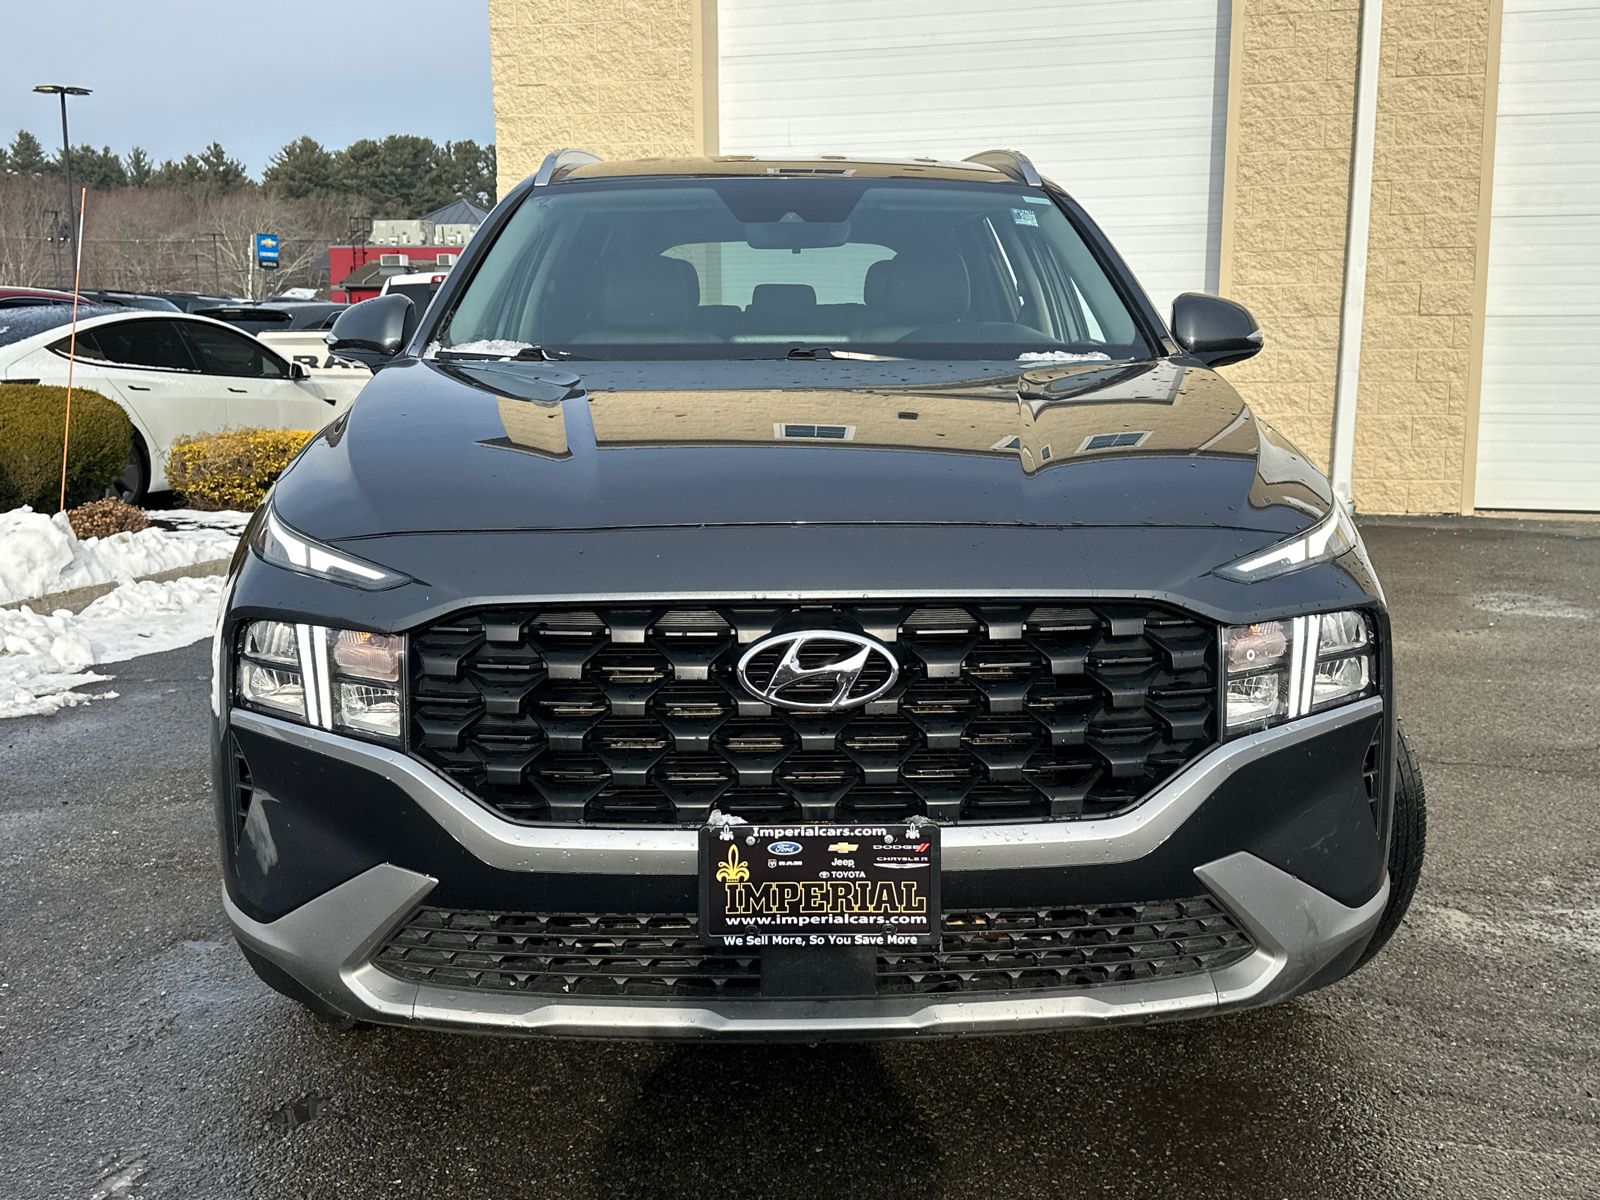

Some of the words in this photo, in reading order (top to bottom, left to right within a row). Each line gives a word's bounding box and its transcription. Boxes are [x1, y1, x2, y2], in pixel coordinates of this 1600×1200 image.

[293, 355, 369, 369] RA
[752, 826, 887, 839] Imperialcars.com
[831, 858, 855, 868] Jeep
[831, 871, 866, 879] TOYOTA
[725, 881, 927, 914] IMPERIAL
[725, 914, 927, 926] www.imperialcars.com
[723, 936, 744, 946] We
[746, 935, 768, 945] Sell
[772, 936, 806, 947] More,
[809, 936, 825, 945] So
[830, 936, 851, 945] You
[855, 935, 882, 945] Save
[887, 935, 918, 945] More
